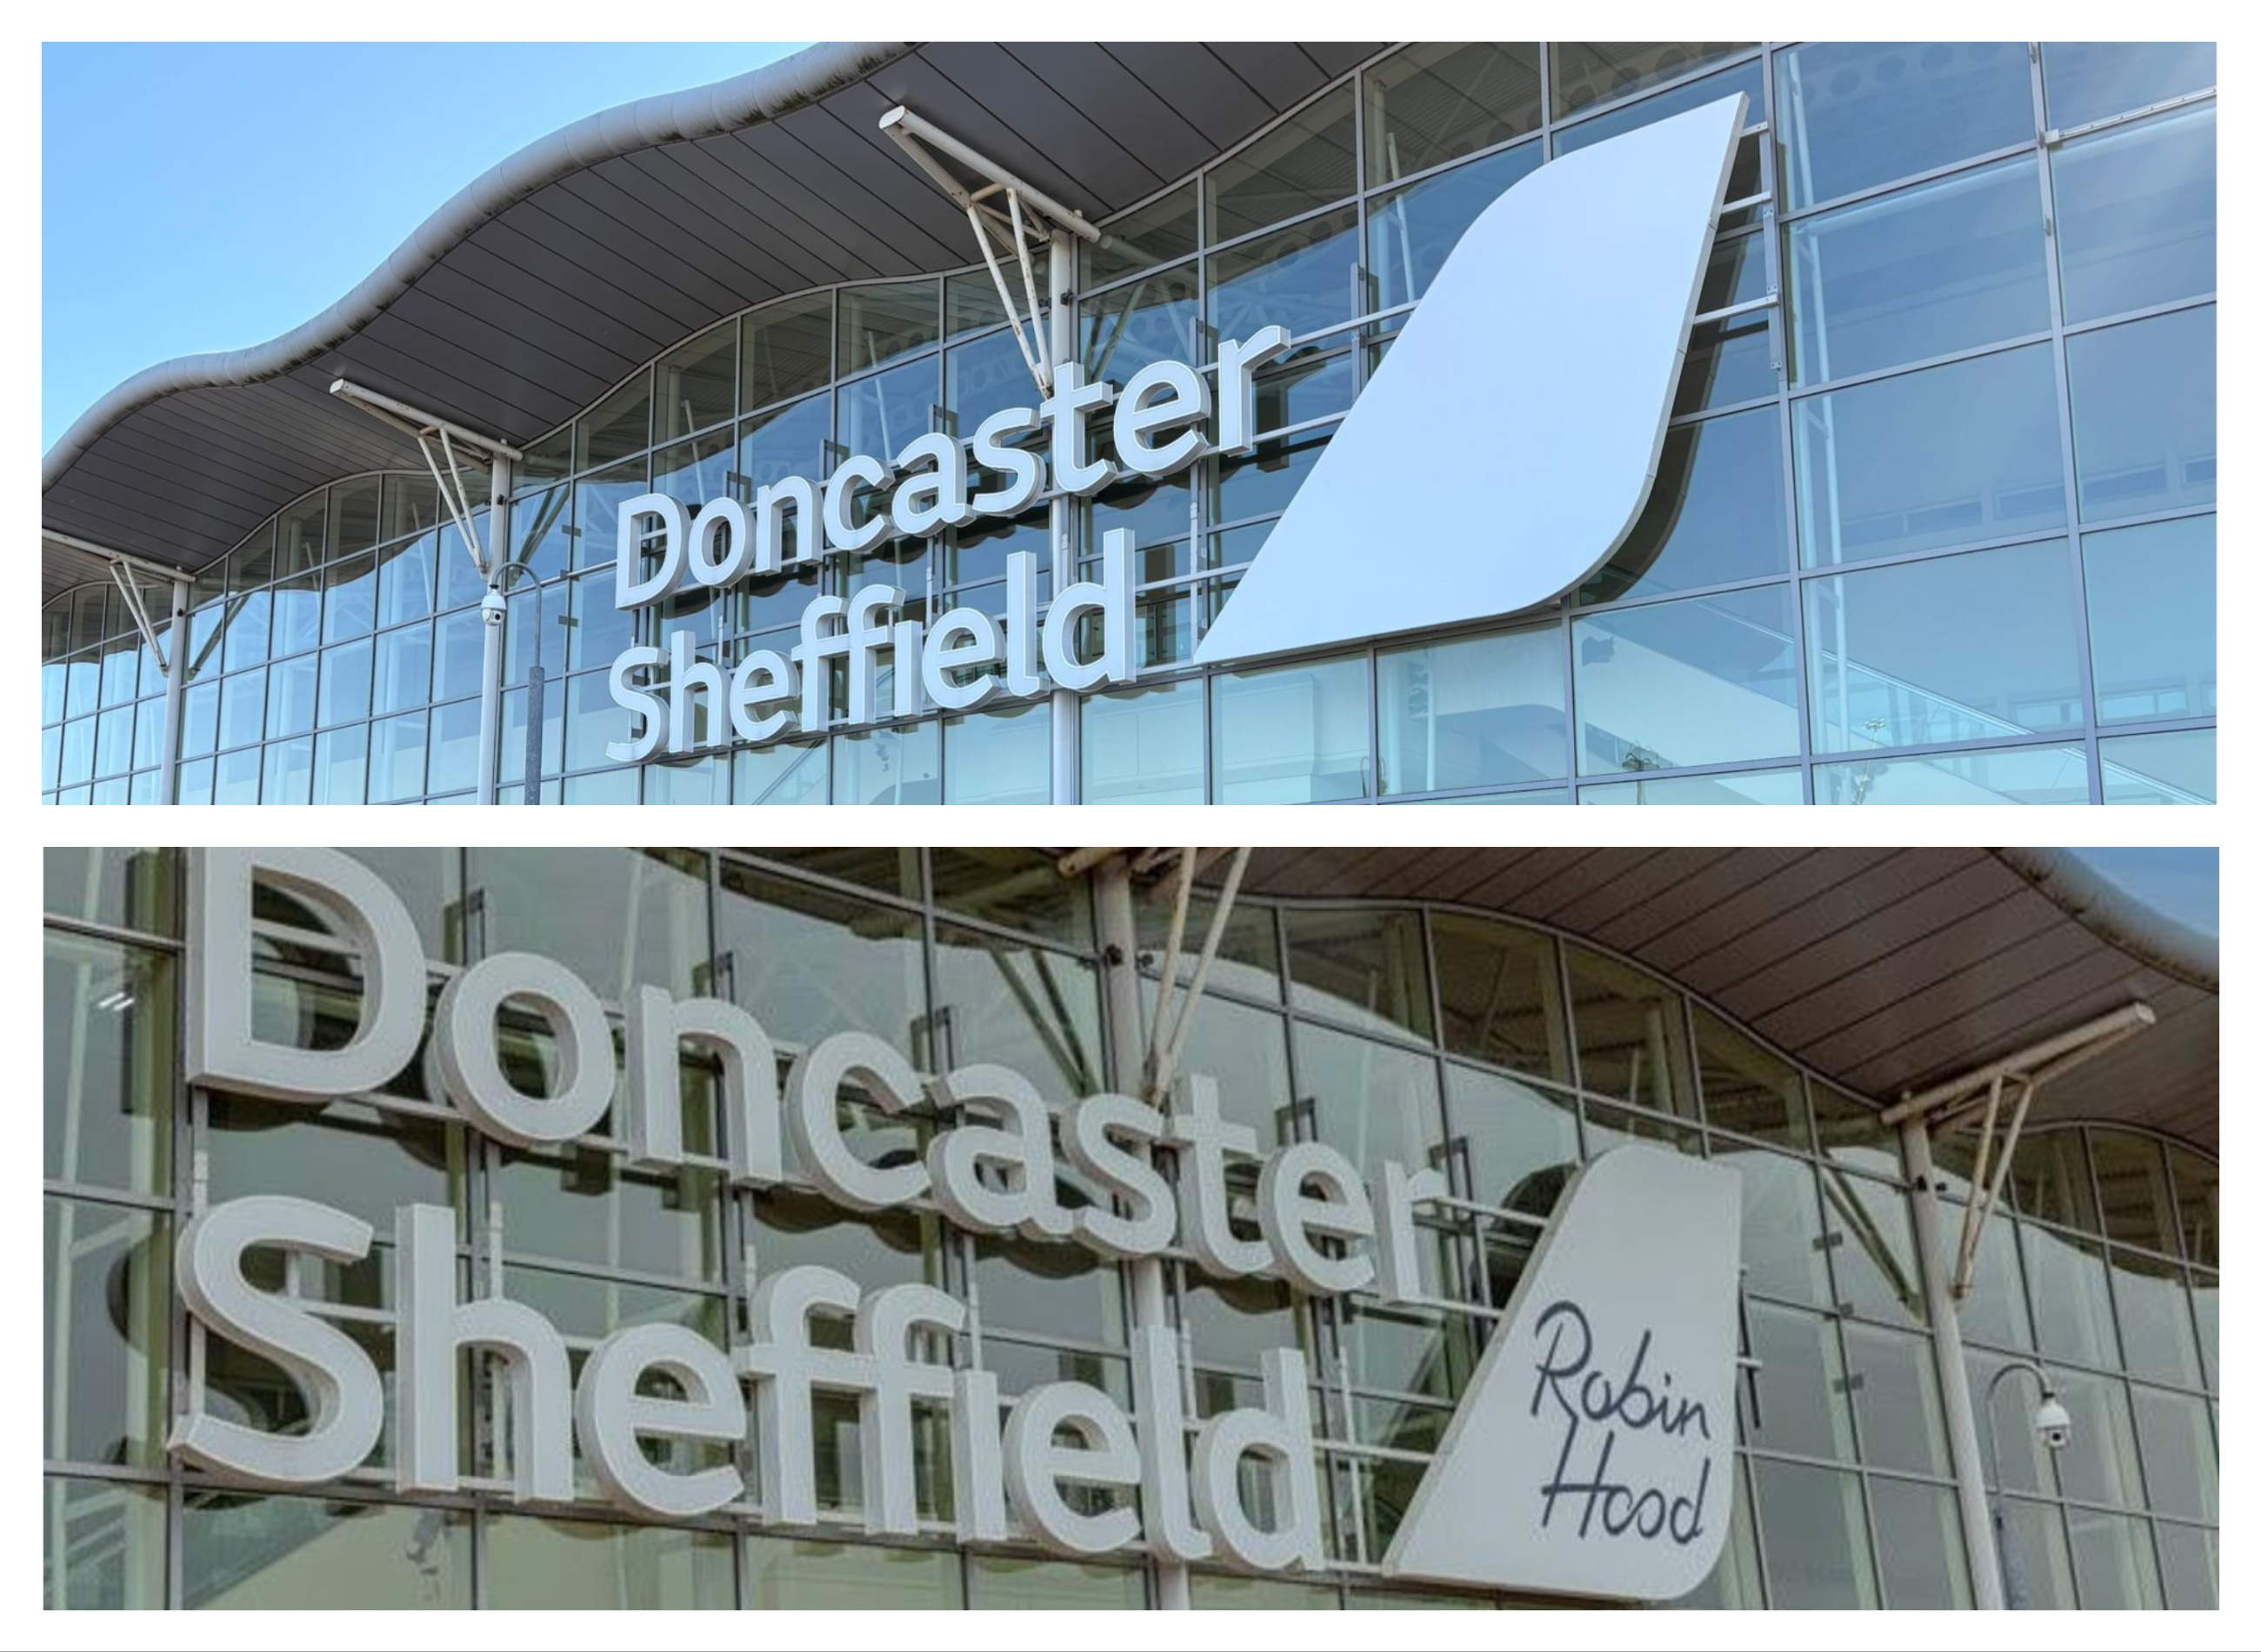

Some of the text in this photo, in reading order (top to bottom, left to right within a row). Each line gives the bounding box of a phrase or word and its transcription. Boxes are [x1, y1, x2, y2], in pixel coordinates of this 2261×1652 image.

[616, 325, 1291, 610] Doncaster
[605, 527, 1137, 763] Sheffield
[185, 847, 1447, 1303] Doncaster
[166, 1195, 1327, 1572] Sheffield
[1531, 1300, 1711, 1440] Robin
[1541, 1417, 1711, 1544] Hood
